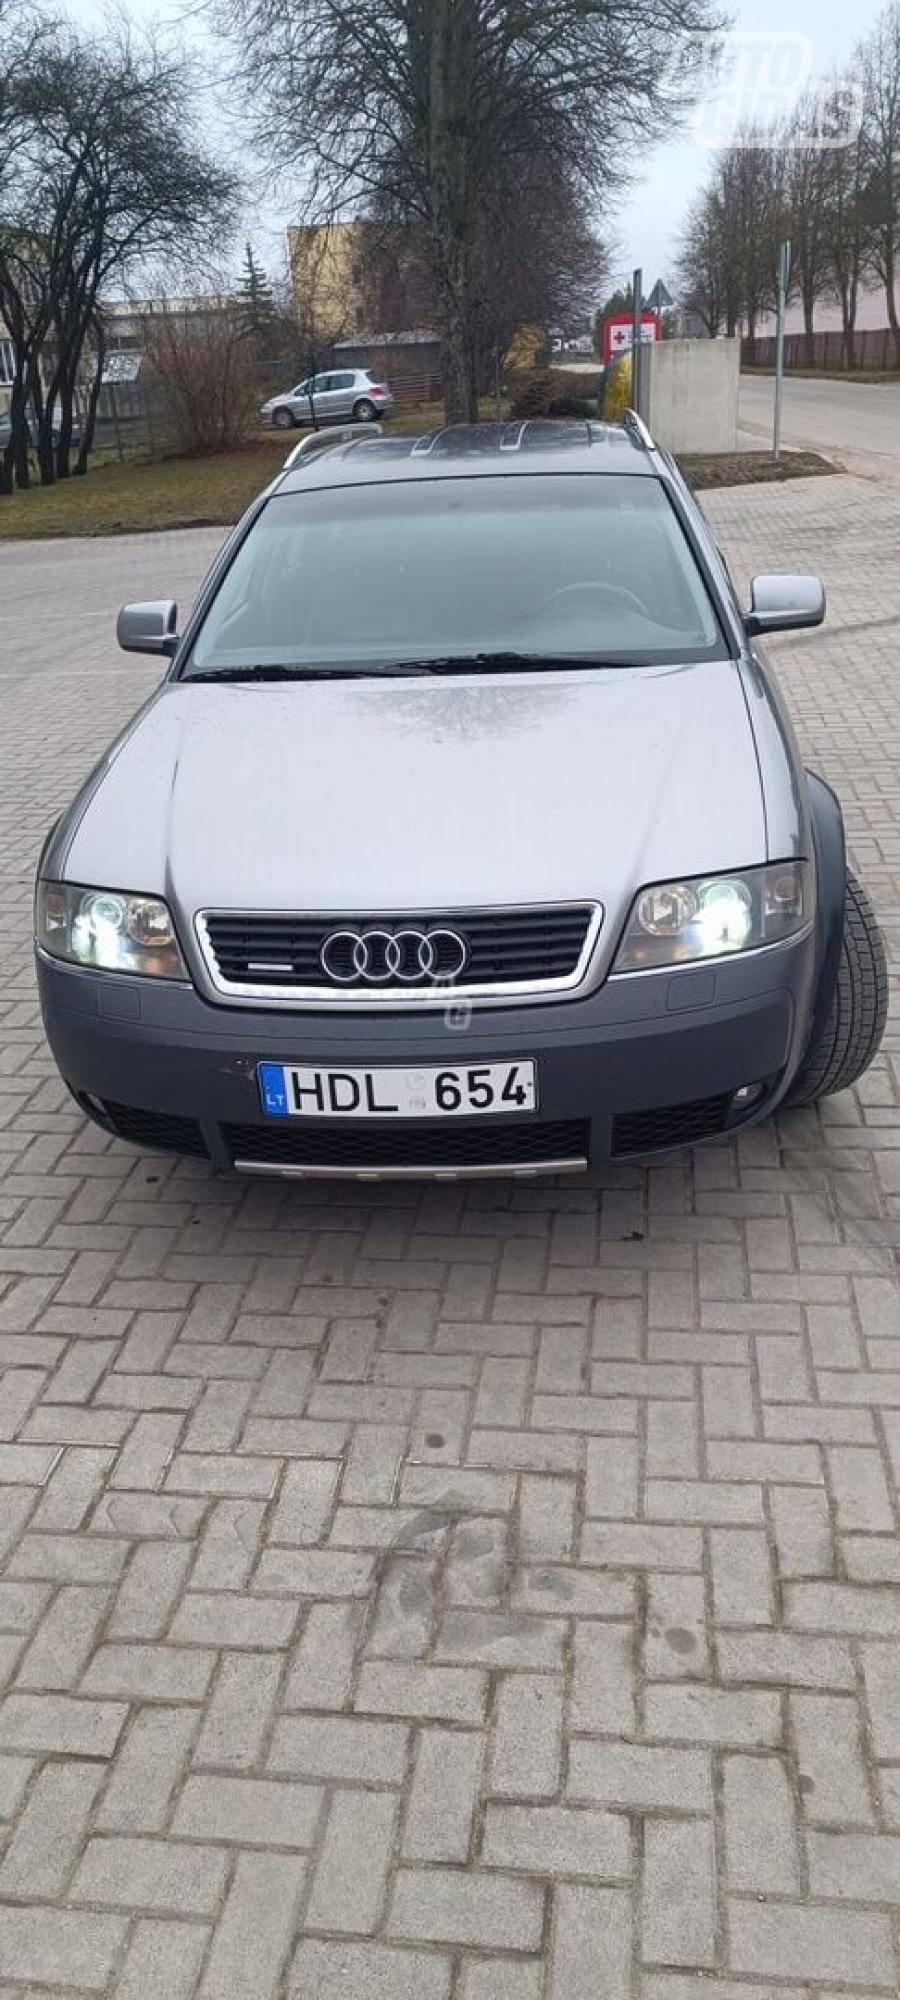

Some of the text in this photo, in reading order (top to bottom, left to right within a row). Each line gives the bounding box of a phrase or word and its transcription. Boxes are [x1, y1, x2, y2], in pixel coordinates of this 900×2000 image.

[266, 1094, 284, 1106] LT
[291, 1066, 527, 1112] HDL 654
